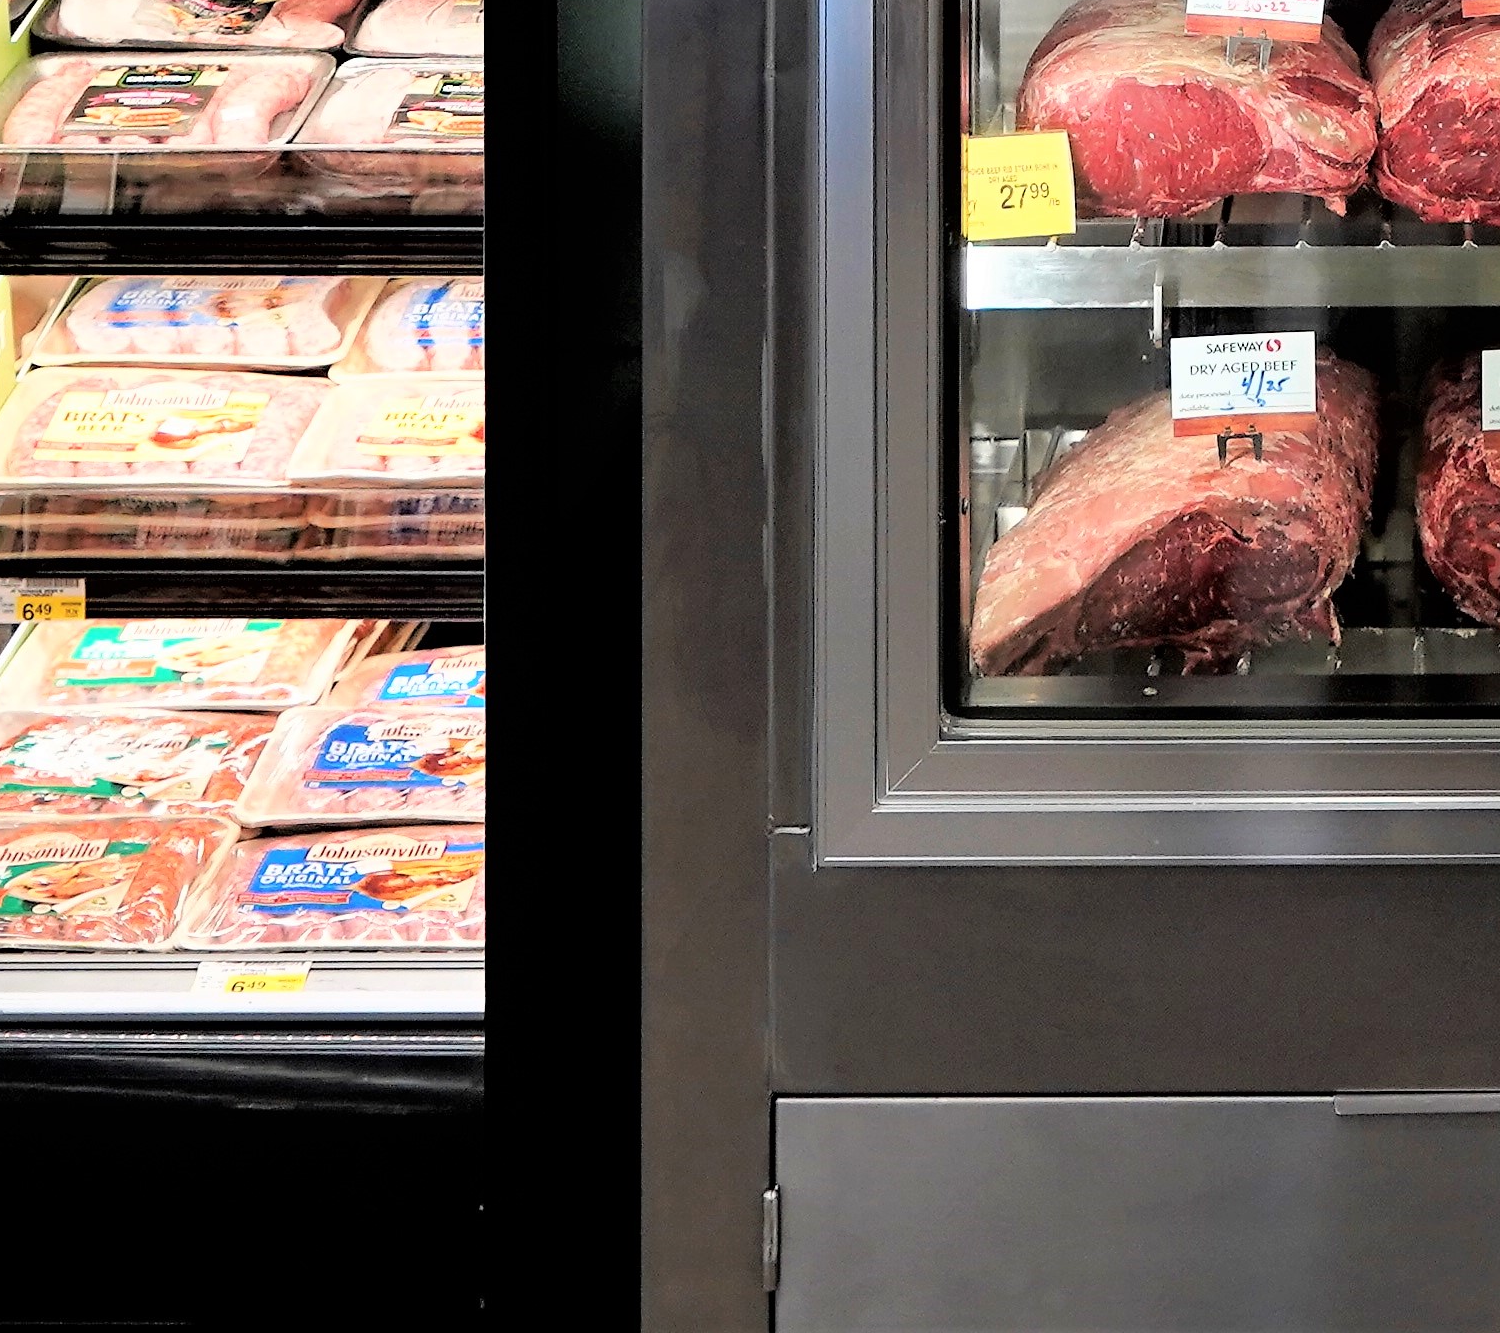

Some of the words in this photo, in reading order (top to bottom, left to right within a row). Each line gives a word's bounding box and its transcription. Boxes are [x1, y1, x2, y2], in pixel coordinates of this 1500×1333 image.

[1206, 339, 1263, 355] SAFEWAY
[1189, 363, 1218, 375] DRY
[1221, 360, 1261, 375] AGED
[1263, 359, 1298, 373] BEEF
[63, 411, 147, 424] BRATS
[310, 842, 442, 863] Johnsonville
[264, 862, 358, 878] BRATS
